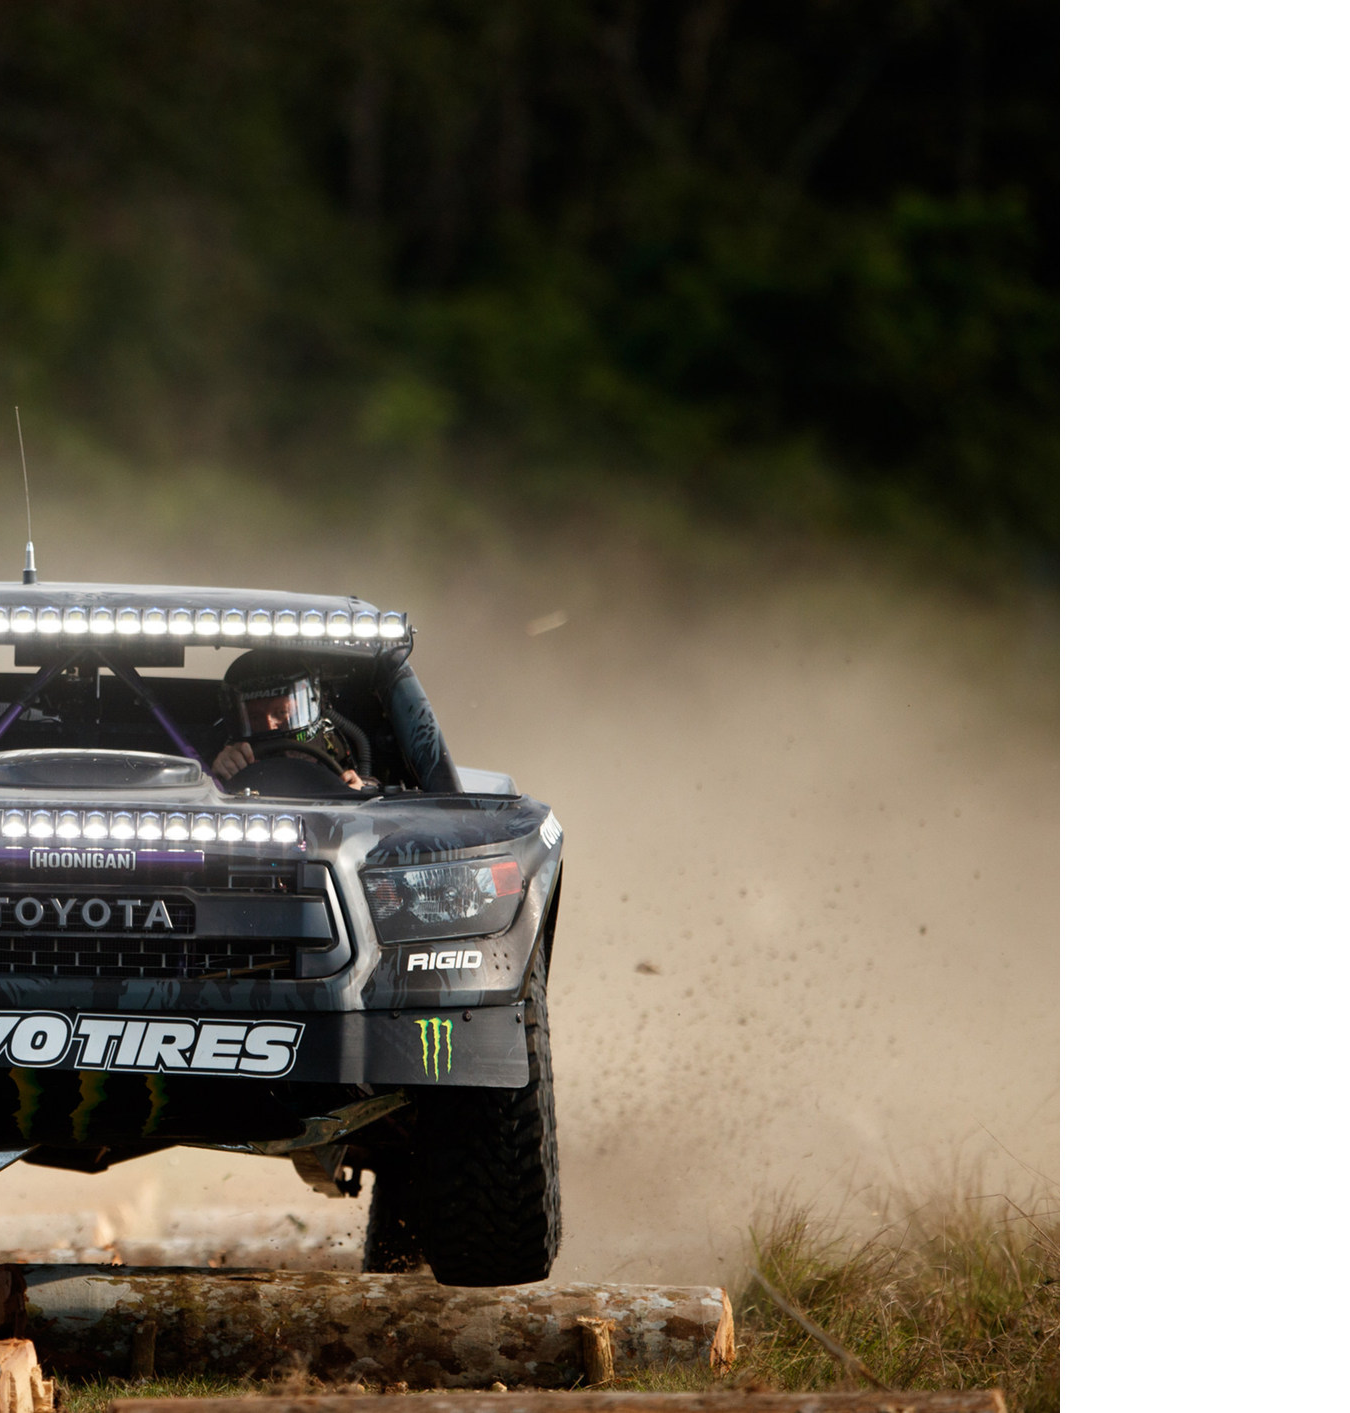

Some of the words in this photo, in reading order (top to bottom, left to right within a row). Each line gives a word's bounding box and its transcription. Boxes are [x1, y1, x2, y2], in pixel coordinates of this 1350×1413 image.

[241, 686, 288, 702] IMPACT
[407, 950, 483, 972] RIGID
[73, 1014, 305, 1077] TIRES
